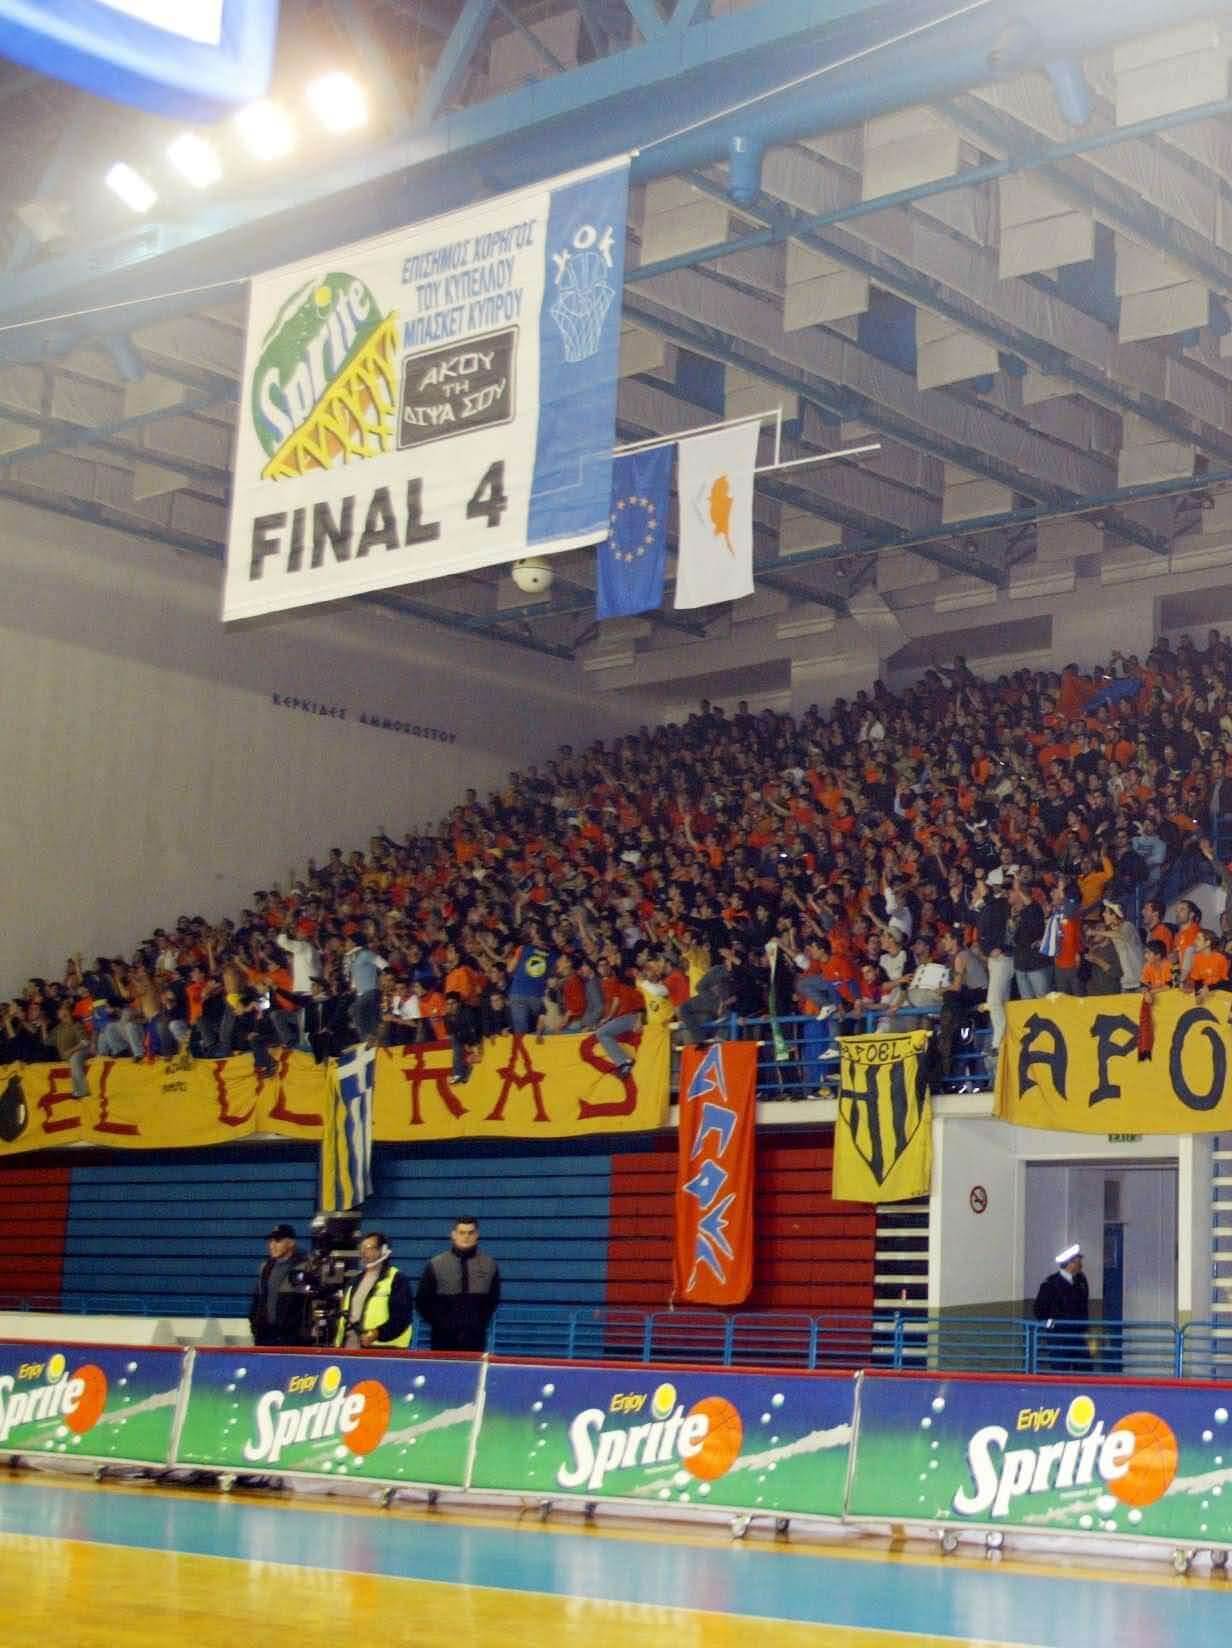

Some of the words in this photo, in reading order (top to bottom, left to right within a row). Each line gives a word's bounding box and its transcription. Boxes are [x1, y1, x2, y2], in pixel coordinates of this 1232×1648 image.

[416, 279, 442, 313] ΤΟΥ
[418, 351, 495, 391] ΑΚΟΥ
[441, 380, 469, 398] ΤΗ
[404, 403, 456, 426] ΔΙΨΑ
[461, 377, 507, 418] ΣΟΥ
[249, 477, 442, 581] FINAL
[466, 459, 510, 528] 4
[18, 1363, 45, 1381] Enjoy
[288, 1374, 320, 1393] Enjoy
[609, 1391, 647, 1413] Enjoy
[1016, 1407, 1060, 1432] Enjoy
[243, 1386, 366, 1463] Sprite
[557, 1405, 710, 1490] Sprite
[953, 1421, 1135, 1517] Sprite
